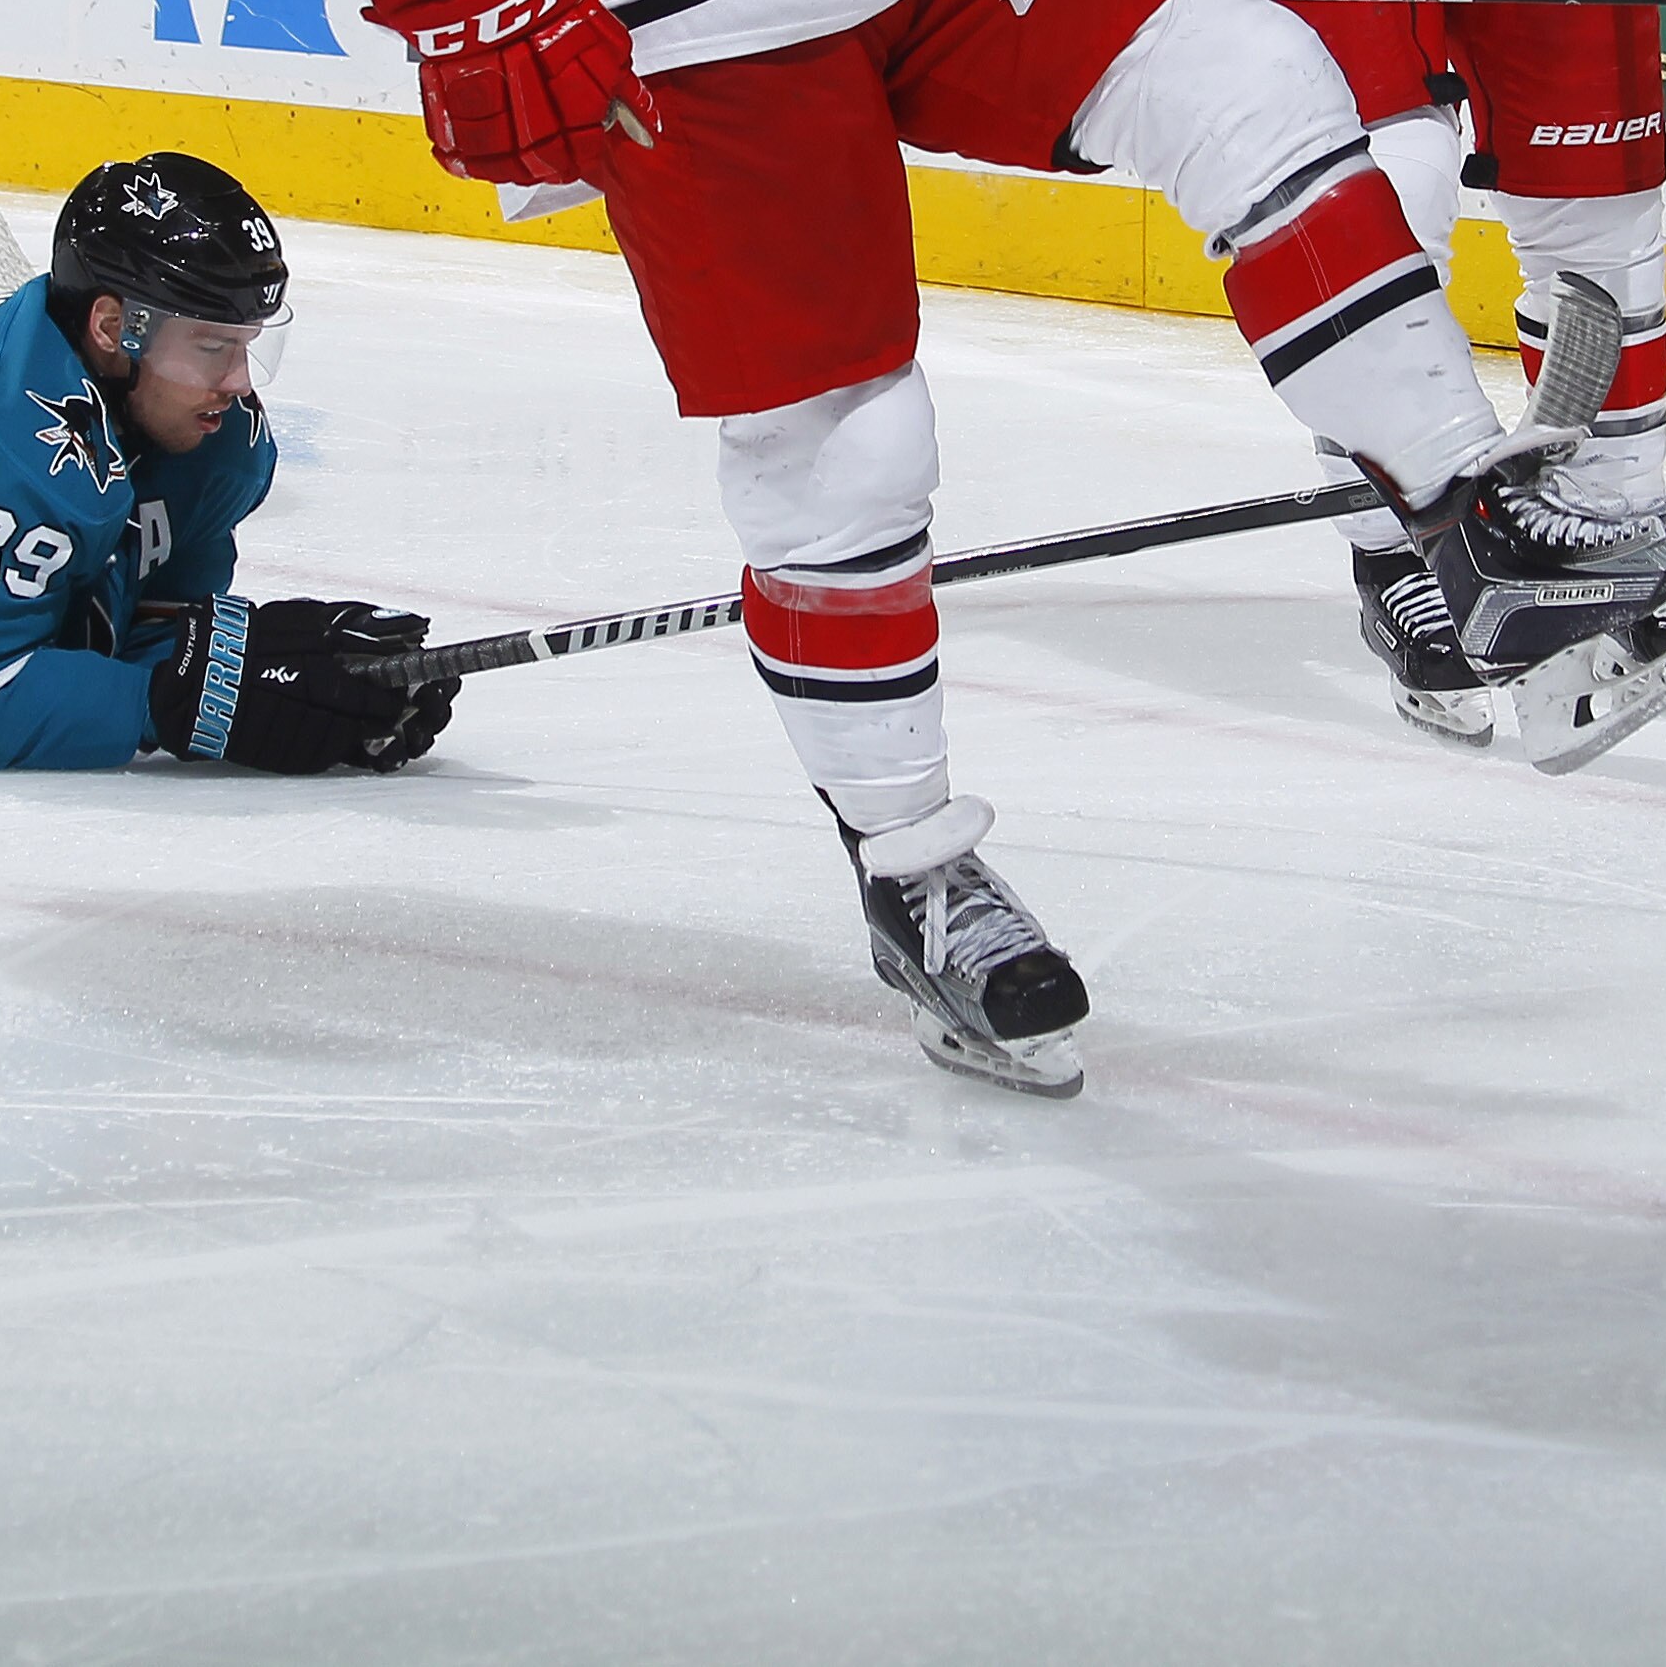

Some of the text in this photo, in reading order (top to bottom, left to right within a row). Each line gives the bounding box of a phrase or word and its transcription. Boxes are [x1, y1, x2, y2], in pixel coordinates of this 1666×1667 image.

[1528, 110, 1662, 147] BAUER
[241, 217, 276, 253] 39
[137, 498, 173, 581] A
[1539, 586, 1611, 602] BAUER
[177, 616, 198, 677] COUTURE
